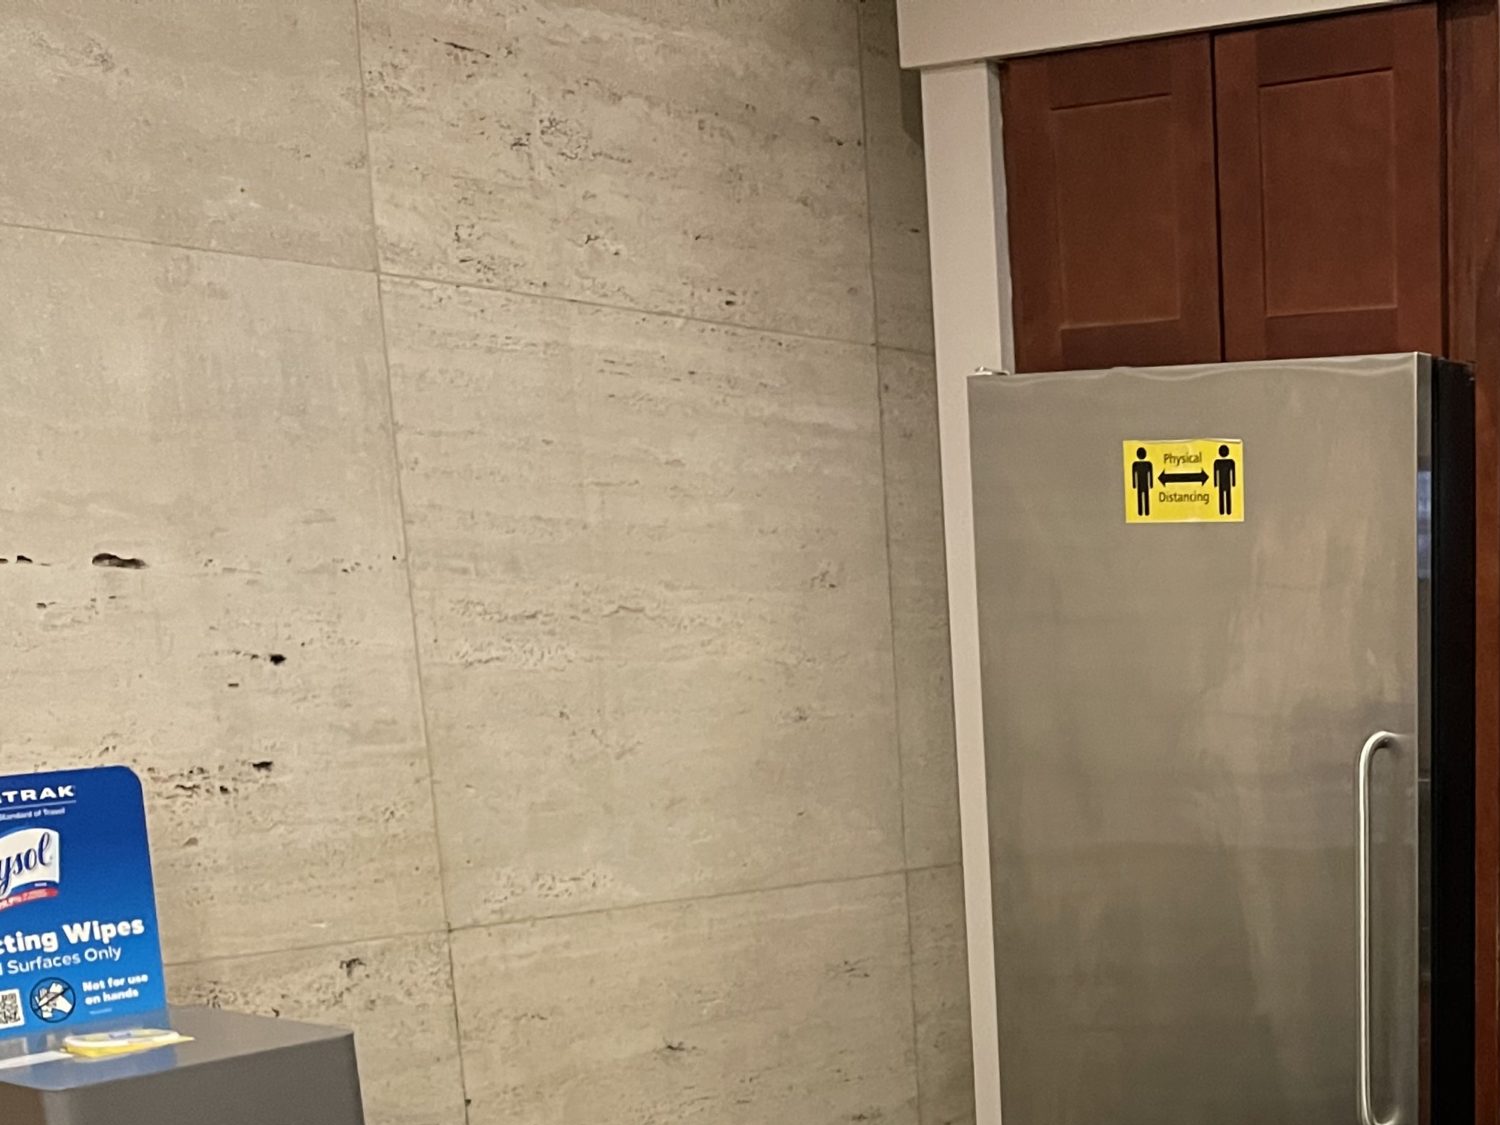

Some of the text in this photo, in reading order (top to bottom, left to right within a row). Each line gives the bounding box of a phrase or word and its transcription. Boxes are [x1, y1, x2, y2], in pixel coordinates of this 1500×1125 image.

[1163, 452, 1202, 467] Physical
[1158, 491, 1210, 504] Distancing
[0, 785, 75, 804] TRAK
[0, 918, 145, 953] ting Wipes
[7, 952, 81, 975] Surfaces
[84, 945, 122, 962] Only
[82, 974, 149, 993] Not for use
[85, 988, 140, 1006] on hands
